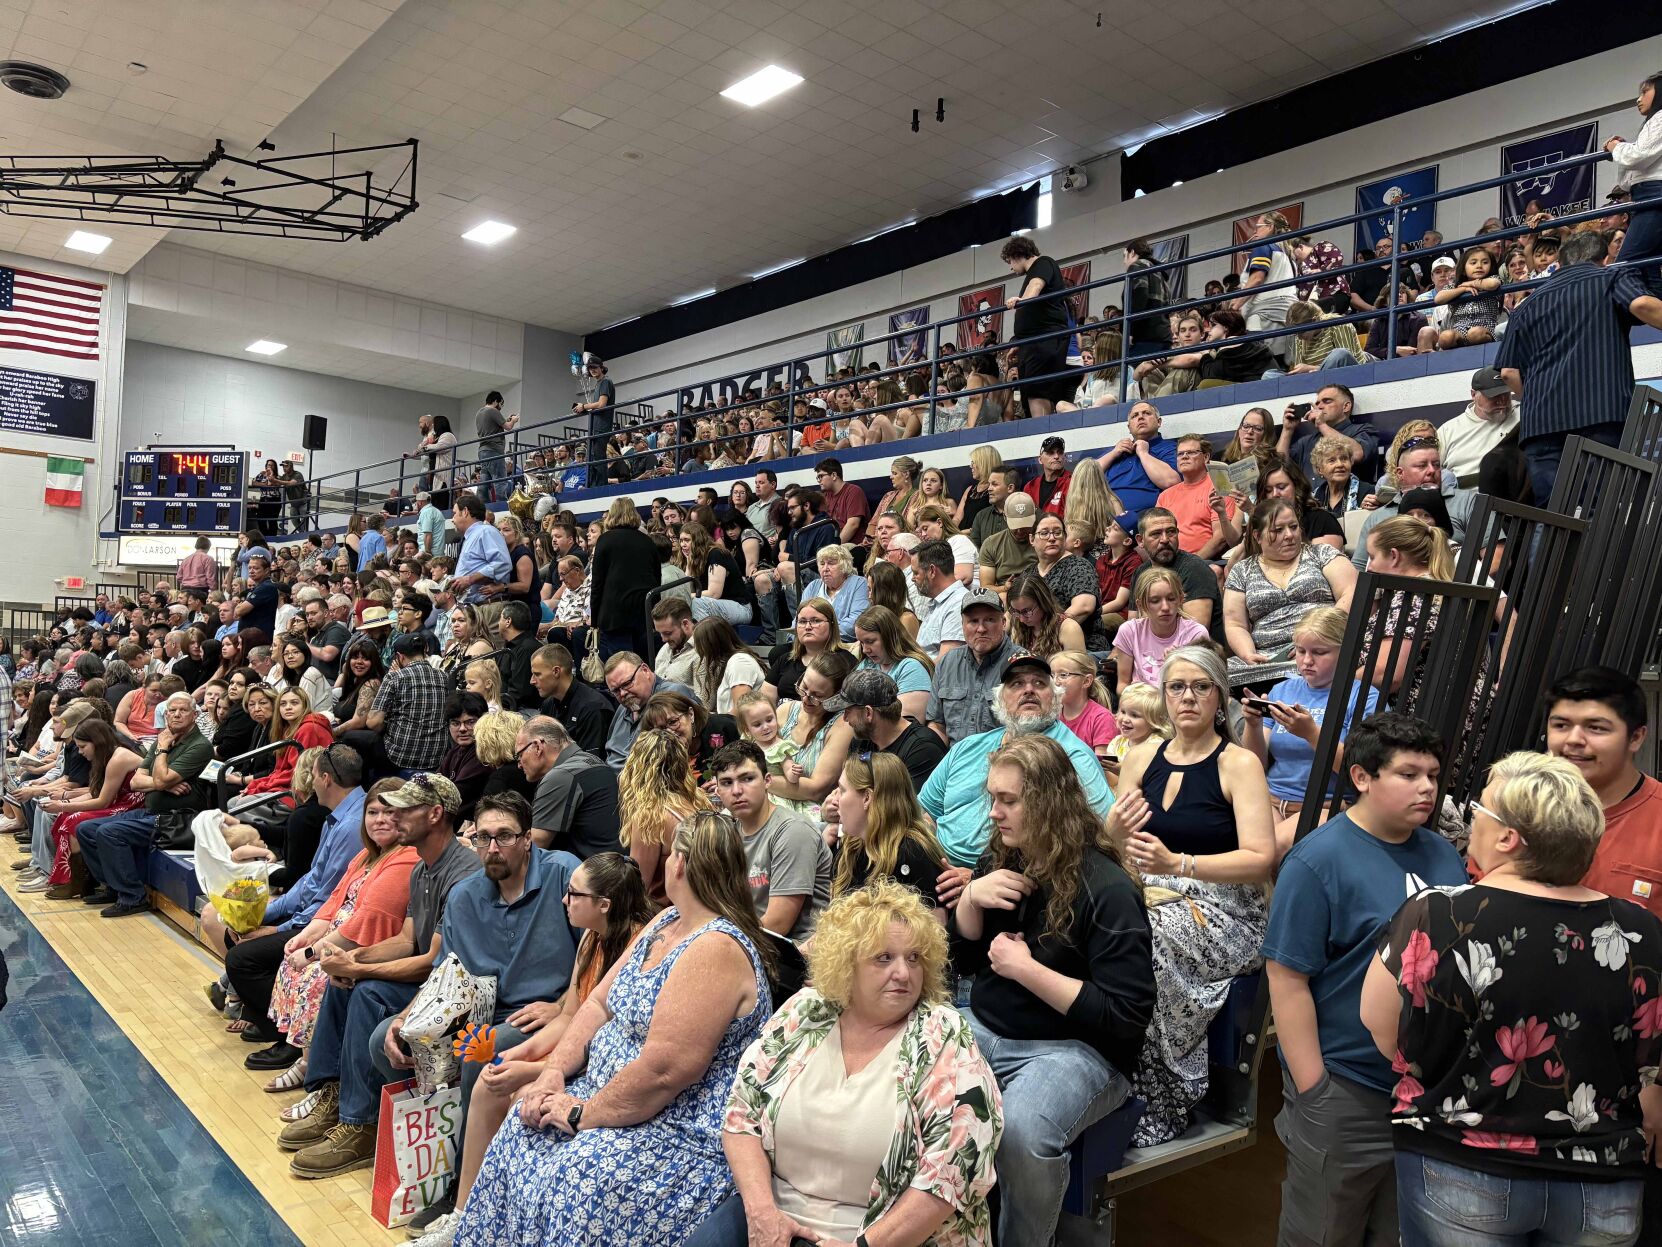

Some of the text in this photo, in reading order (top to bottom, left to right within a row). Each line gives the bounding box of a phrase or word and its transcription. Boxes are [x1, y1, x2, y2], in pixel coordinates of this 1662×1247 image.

[130, 454, 155, 463] HOME
[172, 454, 210, 475] 7:44
[212, 454, 241, 464] GUEST
[404, 1101, 463, 1148] BES
